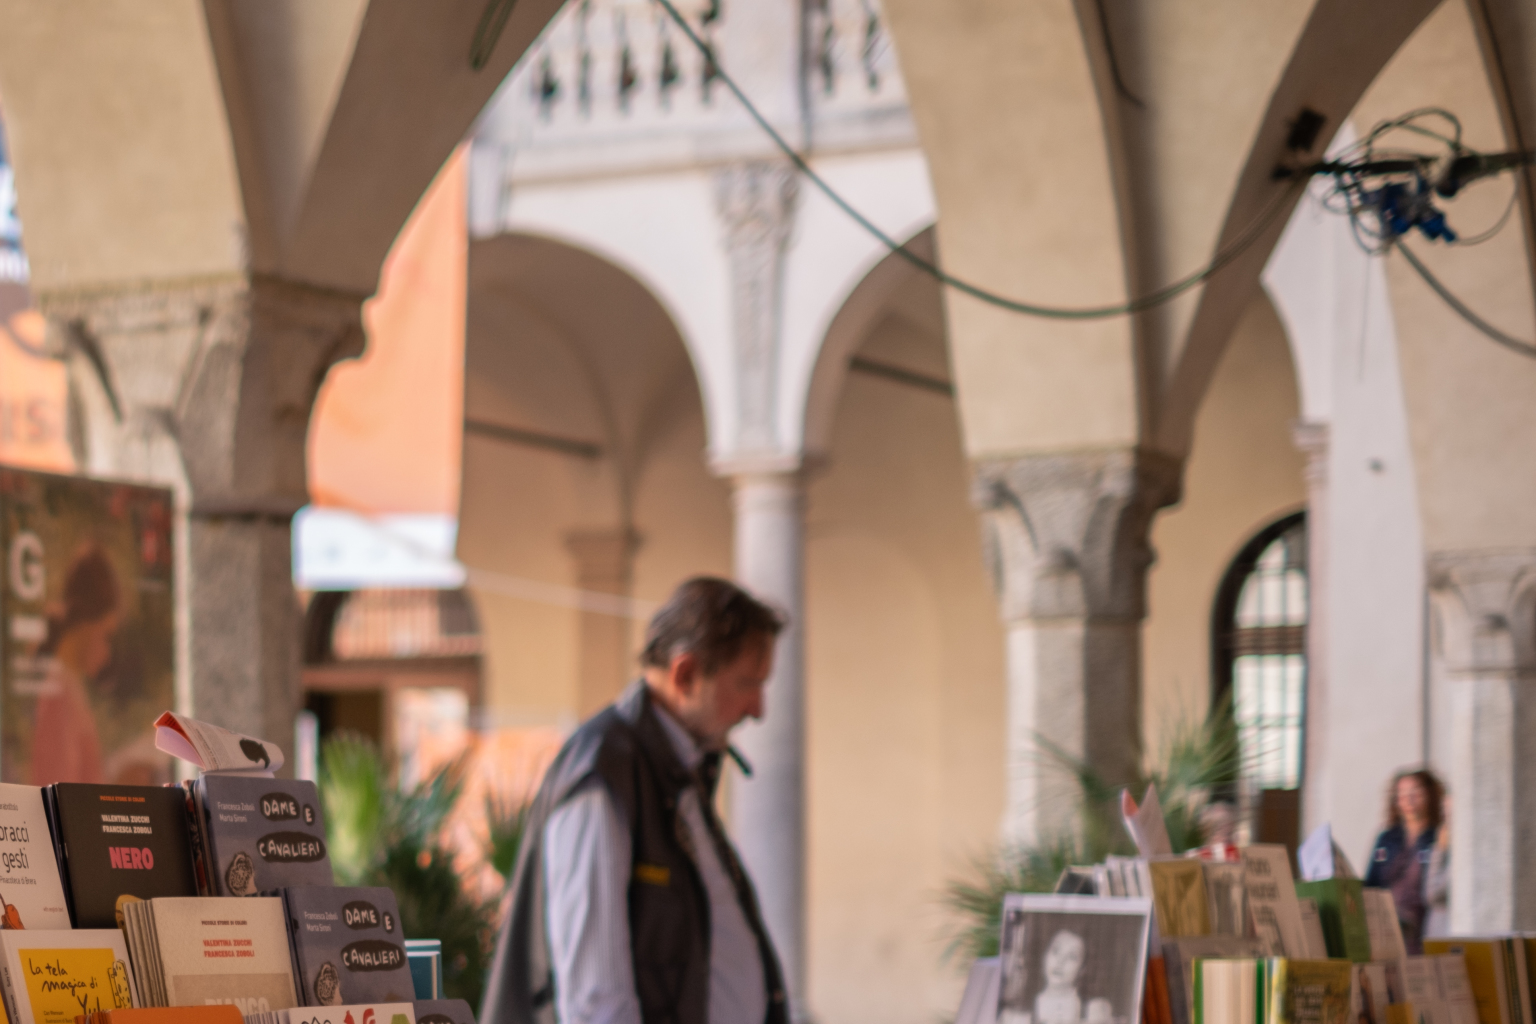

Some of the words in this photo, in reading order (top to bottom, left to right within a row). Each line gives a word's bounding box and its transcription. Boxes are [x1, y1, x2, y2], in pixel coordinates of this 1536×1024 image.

[217, 801, 237, 811] Francesca
[236, 802, 256, 812] Zoboli
[263, 799, 298, 817] DAME
[305, 807, 313, 822] E
[101, 814, 130, 823] VALENTINA
[130, 815, 151, 824] ZUCCHI
[219, 813, 232, 822] Marta
[232, 813, 248, 823] Sironi
[102, 825, 133, 834] FRANCESCA
[132, 826, 153, 835] ZOBOLI
[259, 839, 320, 858] CAVALIERI
[2, 847, 30, 874] gesti
[108, 846, 154, 871] NERO
[303, 910, 324, 920] Francesca
[323, 911, 339, 921] Zoboli
[345, 907, 377, 926] DAME
[384, 914, 392, 931] E
[306, 922, 318, 932] Marta
[318, 923, 332, 932] Sironi
[203, 939, 232, 947] VALENTINA
[233, 939, 253, 947] ZUCCHI
[204, 950, 235, 958] FRANCESCA
[235, 950, 255, 958] ZOBOLI
[343, 948, 400, 966] CAVALIERI
[45, 958, 68, 977] tela
[41, 978, 87, 997] magica
[90, 976, 98, 989] di
